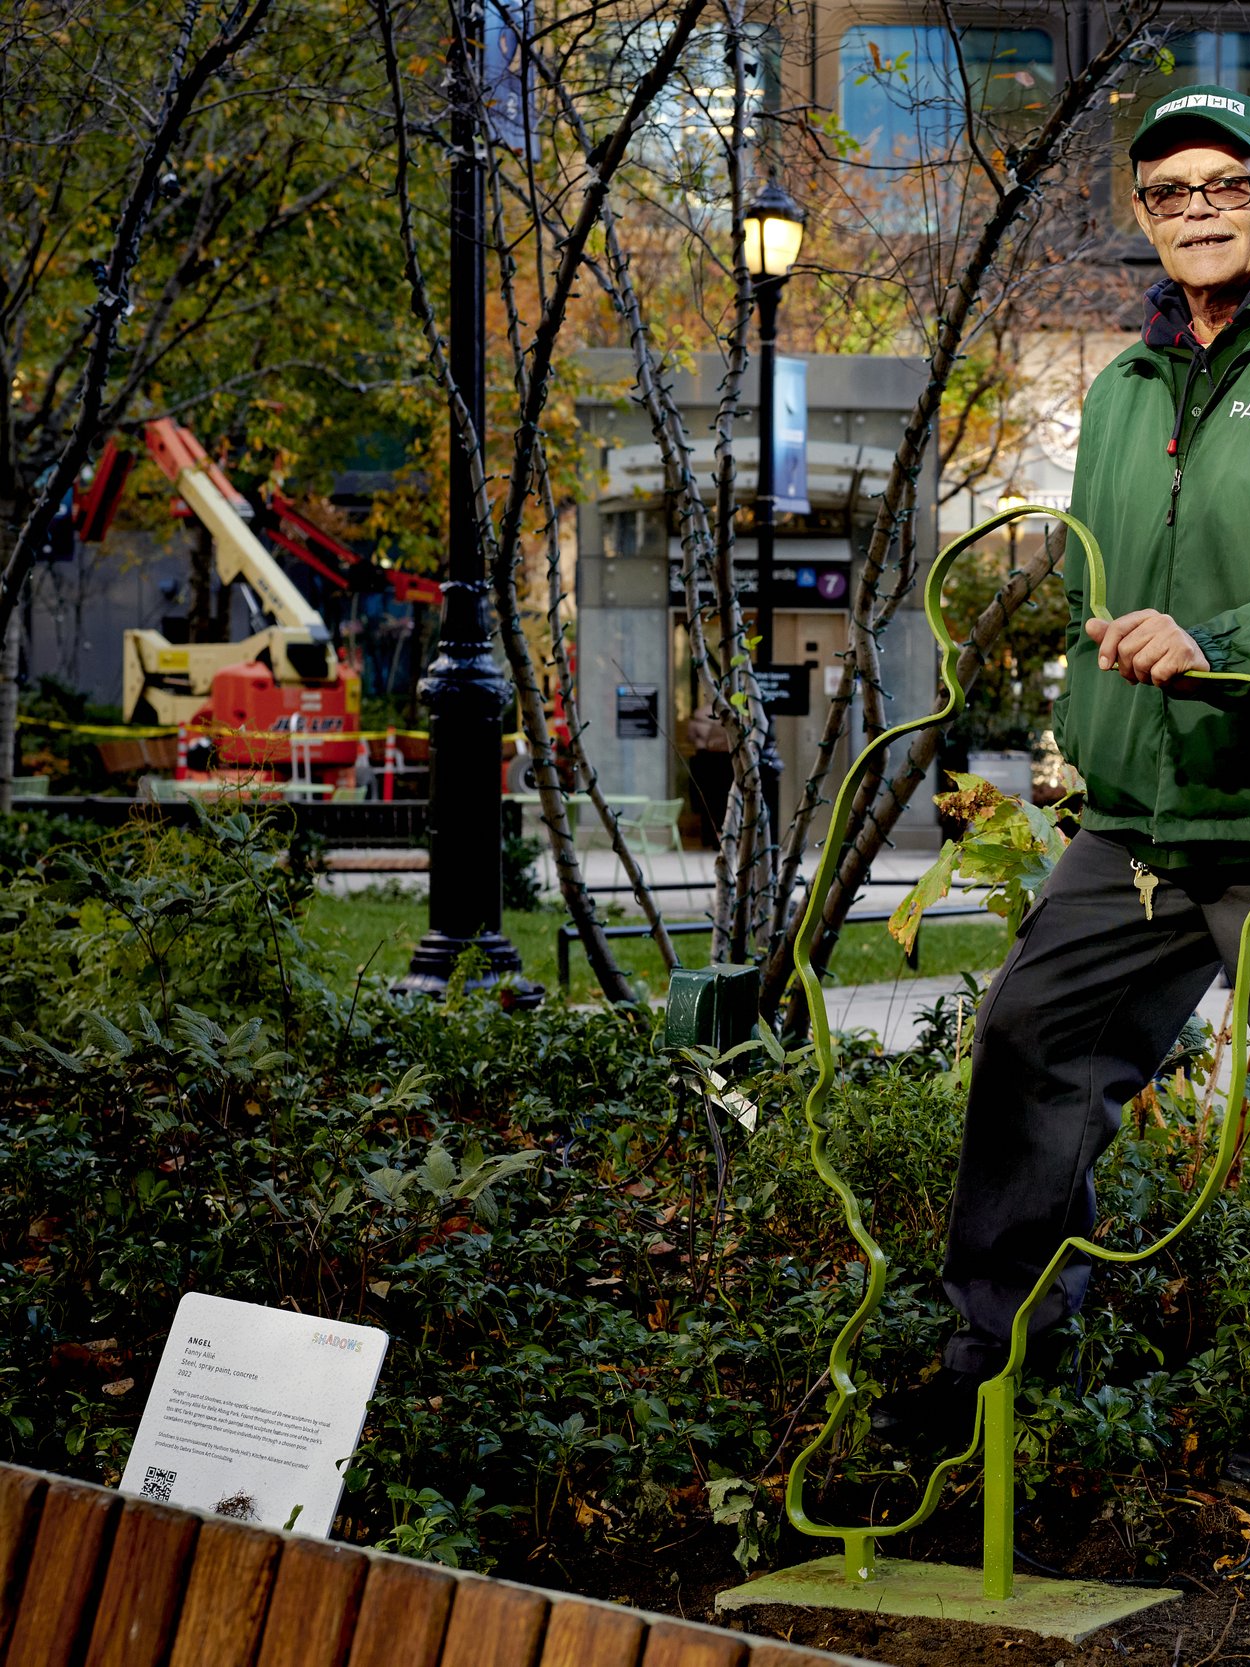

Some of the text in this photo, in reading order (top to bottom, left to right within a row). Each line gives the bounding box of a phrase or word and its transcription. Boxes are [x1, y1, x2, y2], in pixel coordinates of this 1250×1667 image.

[824, 574, 839, 594] 7
[188, 1336, 212, 1348] ANGEL
[311, 1331, 363, 1353] SHADOWS
[184, 1347, 202, 1359] Fanny
[177, 1368, 193, 1378] 2022
[181, 1358, 259, 1381] Steel, spray paint, concrete
